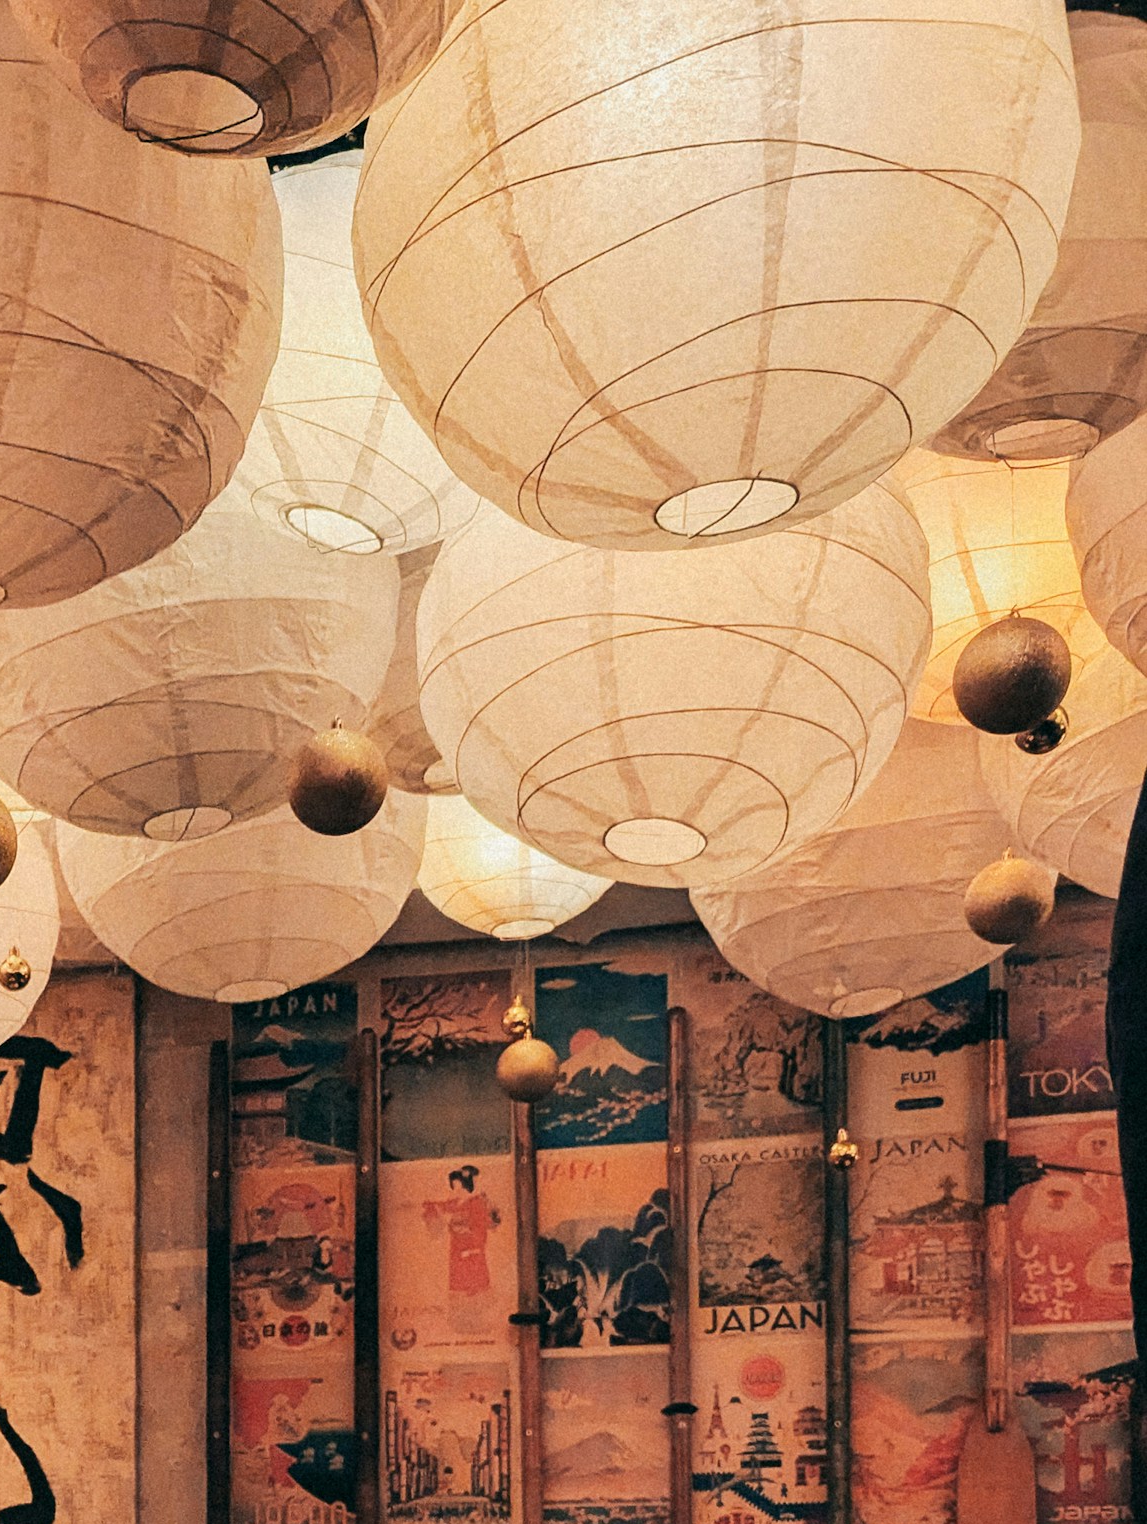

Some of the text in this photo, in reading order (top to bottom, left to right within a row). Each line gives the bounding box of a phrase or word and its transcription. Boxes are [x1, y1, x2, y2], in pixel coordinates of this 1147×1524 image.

[254, 993, 337, 1018] JAPAN
[900, 1071, 937, 1085] FUJI
[699, 1150, 752, 1165] OSAKA
[870, 1137, 967, 1164] JAPAN
[705, 1303, 823, 1335] JAPAN
